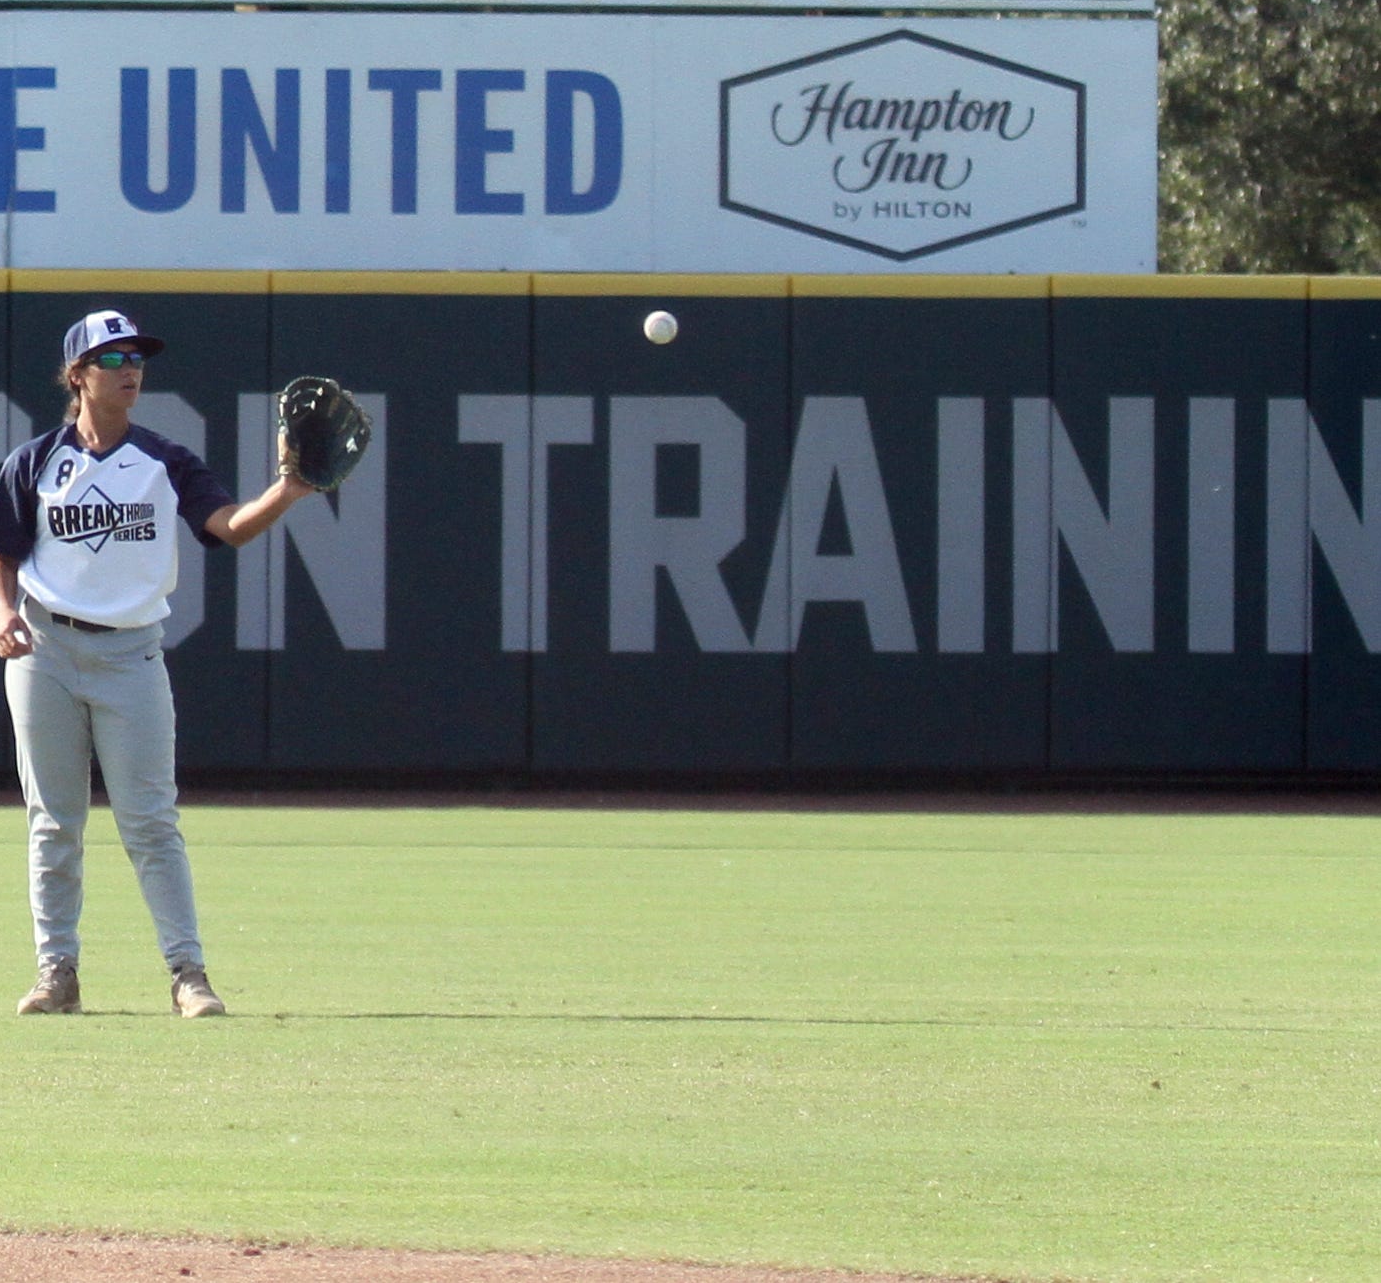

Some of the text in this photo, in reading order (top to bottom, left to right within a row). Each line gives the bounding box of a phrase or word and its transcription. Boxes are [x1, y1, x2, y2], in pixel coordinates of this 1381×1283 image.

[771, 80, 1035, 147] Hampton
[119, 67, 624, 215] UNITED
[833, 137, 973, 194] Inn
[833, 201, 972, 222] by HILTON
[55, 458, 75, 489] 8
[113, 522, 156, 542] SERIES
